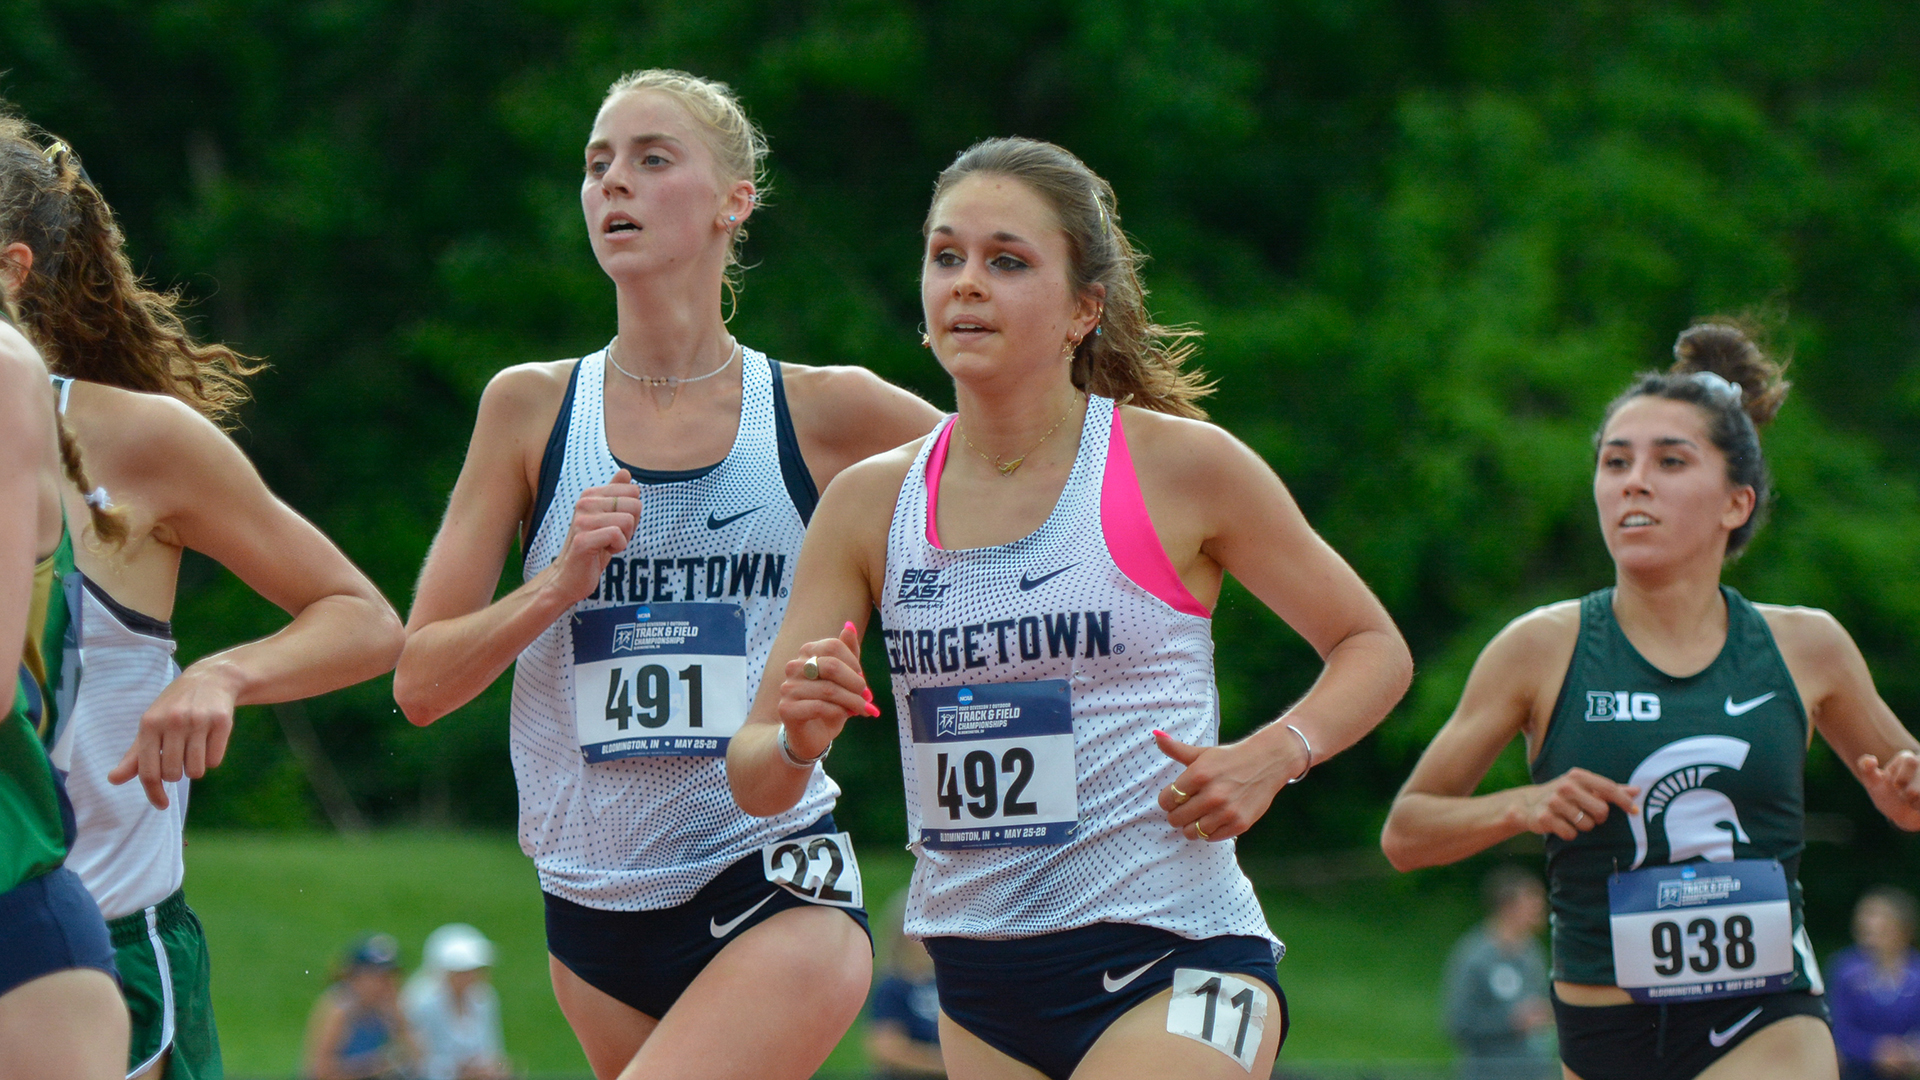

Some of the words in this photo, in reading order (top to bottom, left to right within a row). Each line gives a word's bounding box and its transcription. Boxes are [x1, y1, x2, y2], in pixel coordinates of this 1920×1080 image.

[901, 569, 941, 584] BIG
[898, 584, 951, 599] EAST
[636, 627, 664, 638] TRACK
[664, 626, 673, 637] &
[673, 626, 699, 637] FIELD
[634, 637, 685, 646] CHAMPIONSHIPS
[605, 664, 703, 731] 491
[959, 710, 987, 722] TRACK
[987, 709, 995, 720] &
[995, 707, 1020, 719] FIELD
[957, 720, 1008, 731] CHAMPIONSHIPS
[650, 739, 660, 749] IN
[674, 739, 693, 749] MAY
[693, 739, 718, 749] 25-28
[937, 747, 1038, 820] 492
[982, 830, 990, 840] IN
[1004, 828, 1023, 839] MAY
[1022, 827, 1047, 838] 25-28
[771, 837, 852, 903] 22
[1651, 915, 1755, 976] 938
[1195, 977, 1254, 1059] 11
